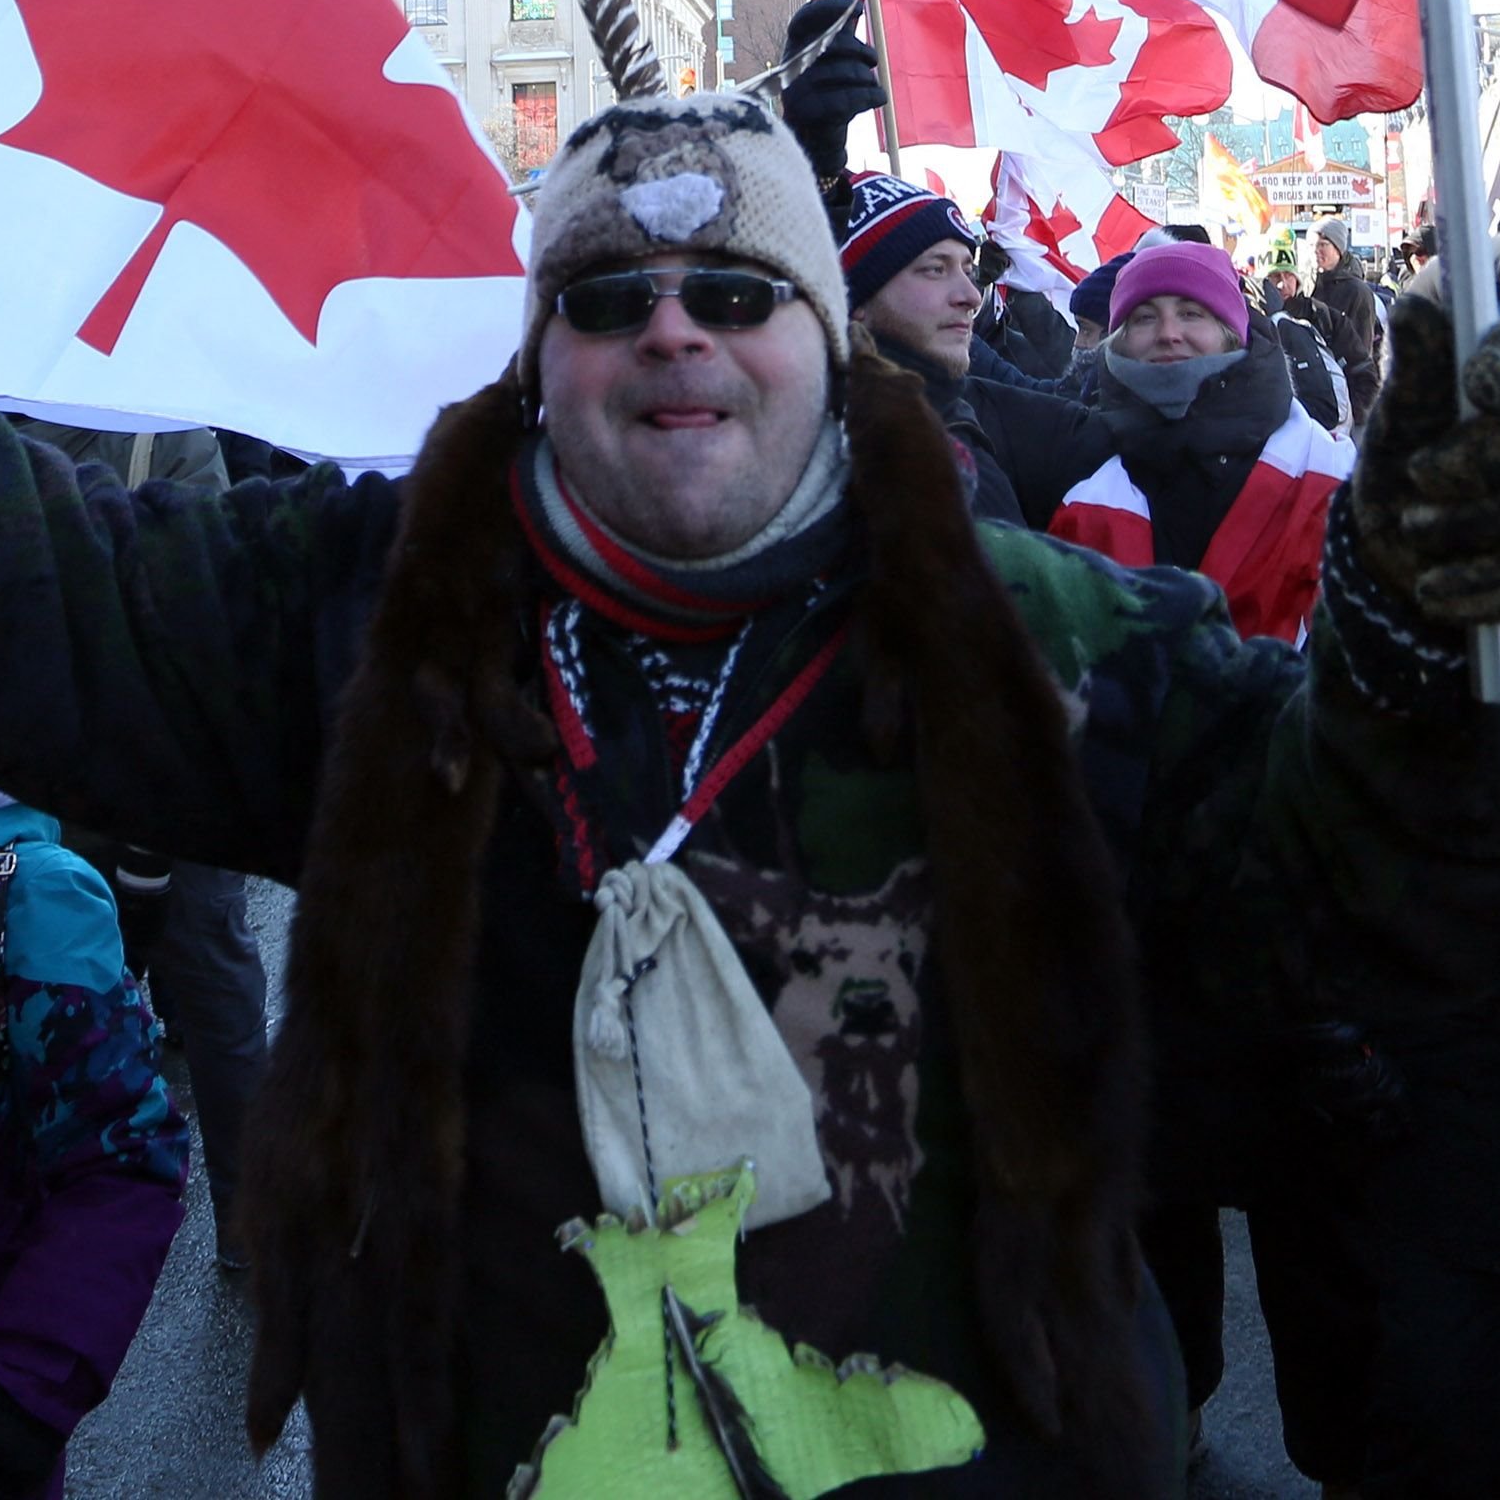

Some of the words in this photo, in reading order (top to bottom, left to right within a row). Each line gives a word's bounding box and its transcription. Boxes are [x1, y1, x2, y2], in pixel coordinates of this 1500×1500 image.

[1283, 175, 1302, 186] KEEP
[1306, 175, 1323, 186] OUR
[1307, 189, 1323, 200] AND
